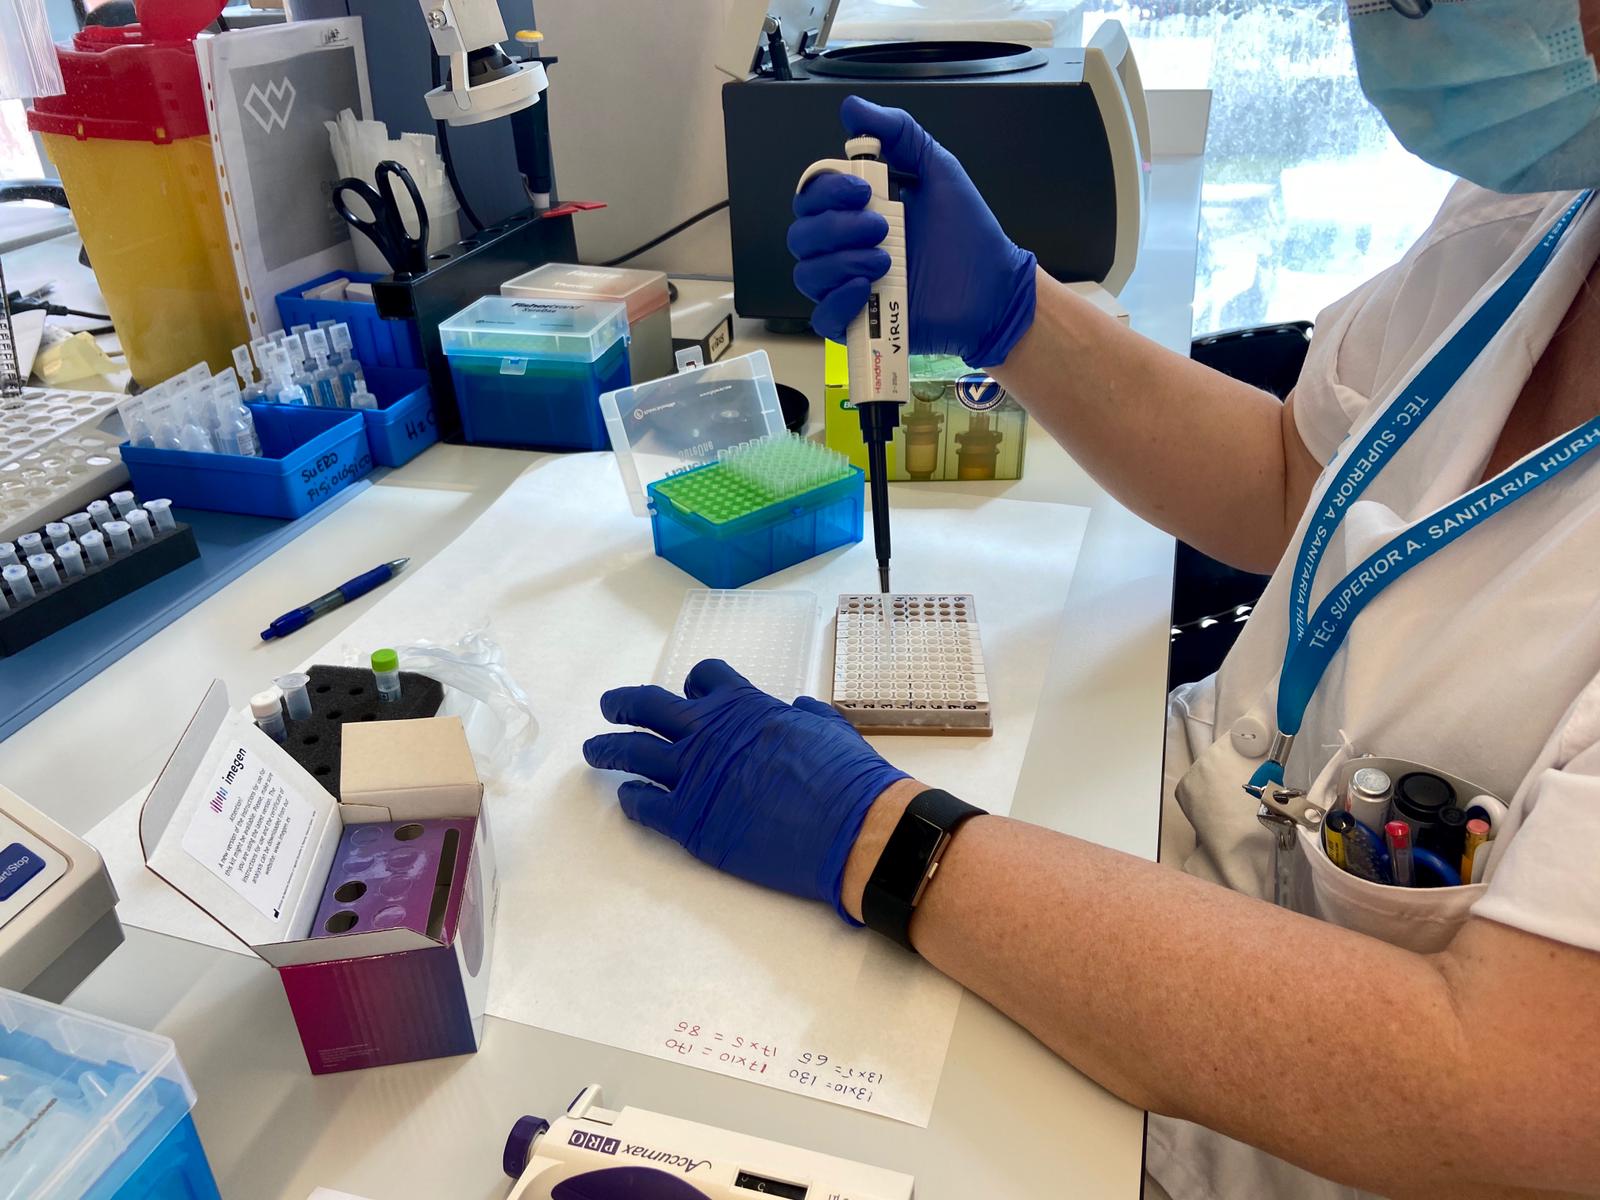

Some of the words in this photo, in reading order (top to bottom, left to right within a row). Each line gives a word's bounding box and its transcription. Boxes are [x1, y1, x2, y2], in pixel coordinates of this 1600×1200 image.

[1333, 430, 1396, 508] SUPERIOR
[1323, 506, 1336, 520] A.
[1330, 549, 1403, 620] SUPERIOR
[1405, 539, 1427, 556] A.
[1428, 471, 1539, 540] SANITARIA
[1298, 525, 1327, 606] SANITARIA
[222, 747, 247, 786] imegen
[674, 1021, 701, 1037] 85
[665, 1039, 693, 1055] 170
[798, 1052, 828, 1066] 65
[789, 1069, 817, 1086] 130
[569, 1130, 620, 1155] PRO
[622, 1144, 712, 1173] Accumax
